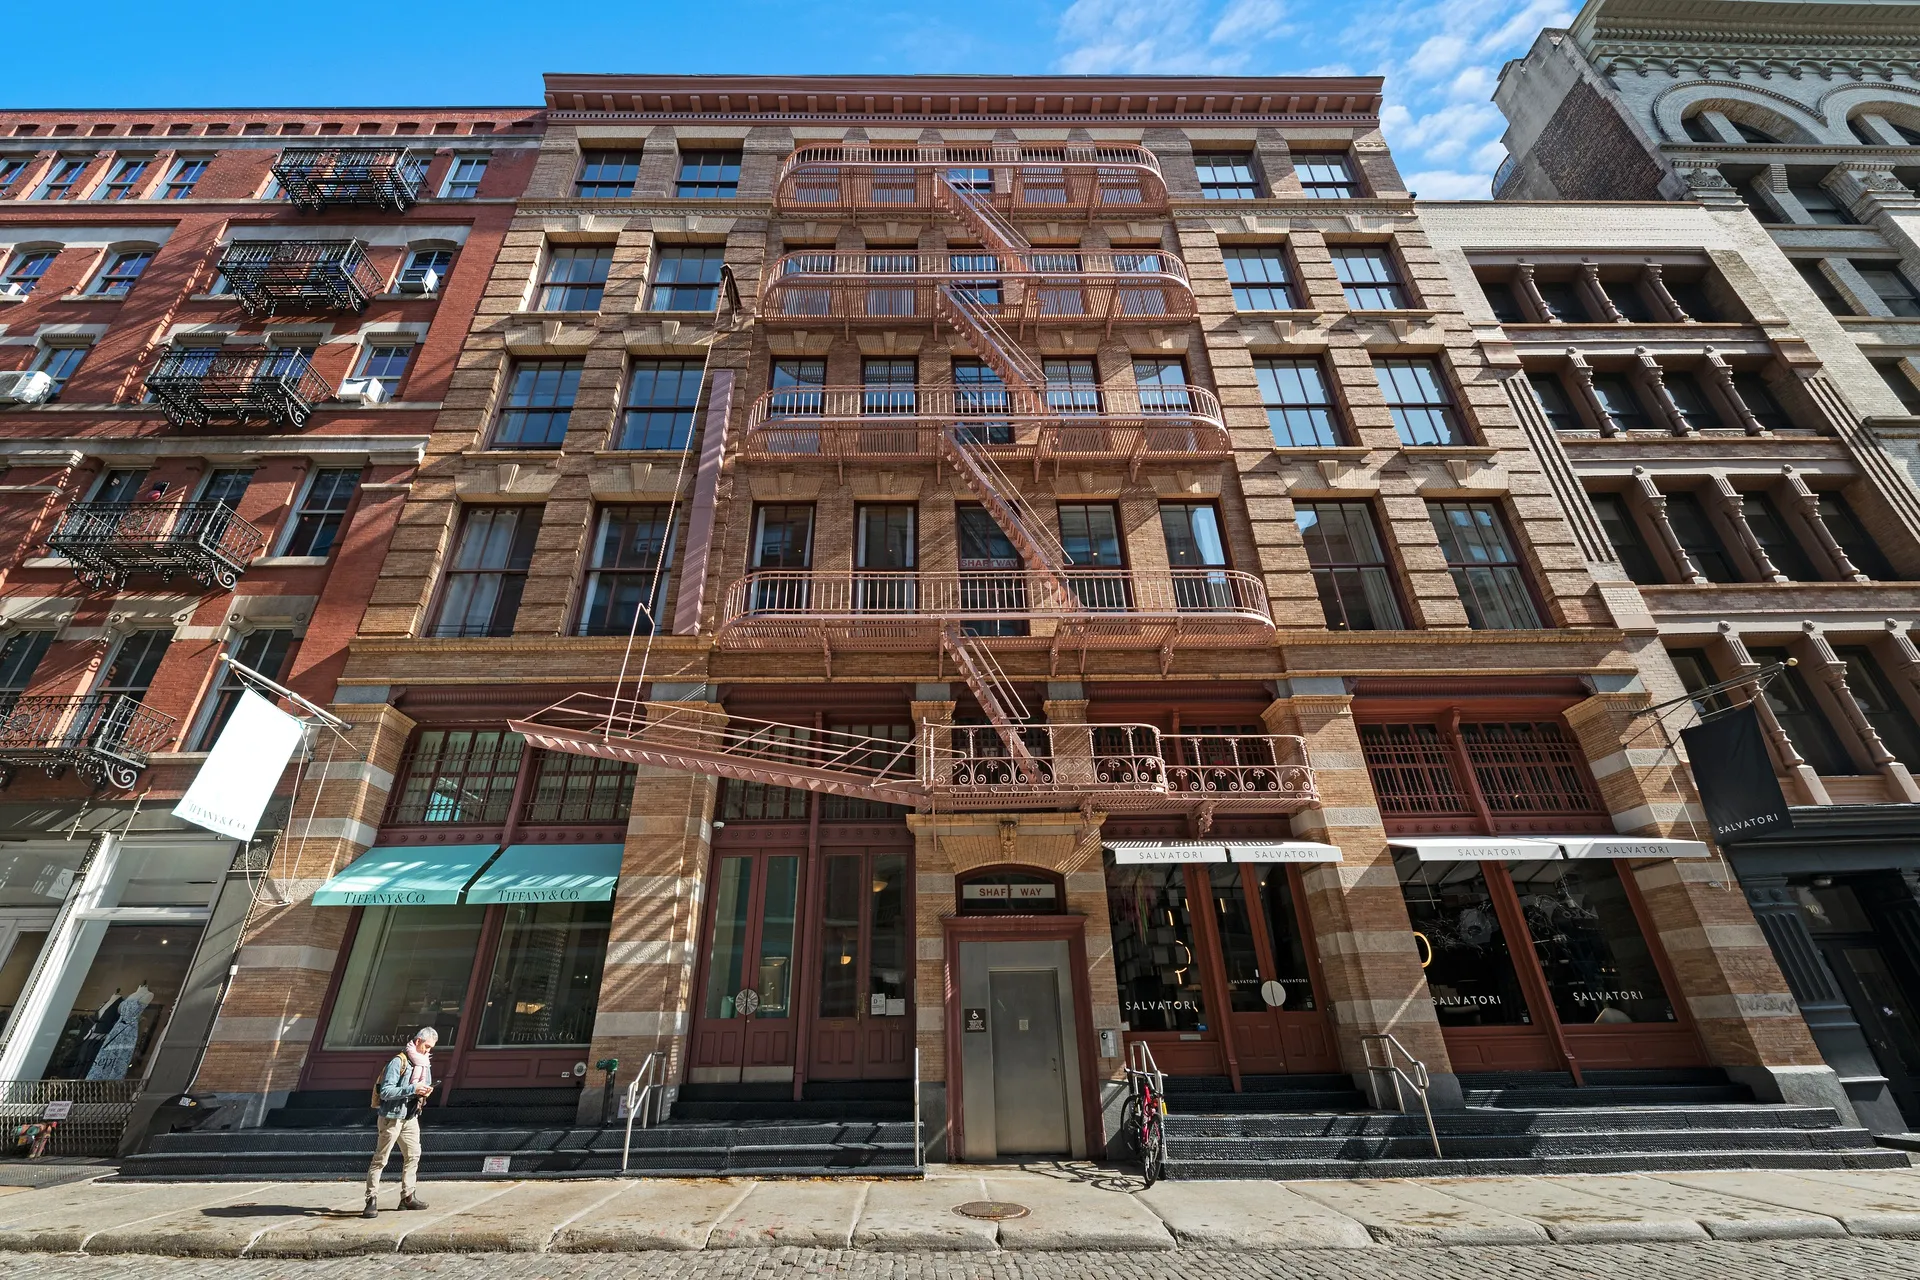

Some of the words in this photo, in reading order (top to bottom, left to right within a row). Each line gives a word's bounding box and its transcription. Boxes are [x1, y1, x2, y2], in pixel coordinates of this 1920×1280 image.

[186, 799, 220, 823] IFFANY
[1718, 813, 1779, 834] SALVATORI
[1255, 850, 1319, 859] SALVATORI
[1458, 848, 1522, 857] SALVATORI
[1606, 846, 1670, 854] SALVATORI
[1139, 851, 1203, 860] SALVATORI
[979, 887, 1013, 897] SHAFT
[1020, 888, 1042, 896] WAY
[1431, 995, 1502, 1006] SALVATORI
[1573, 990, 1644, 1001] SALVATORI
[1125, 1000, 1196, 1011] SALVATORI
